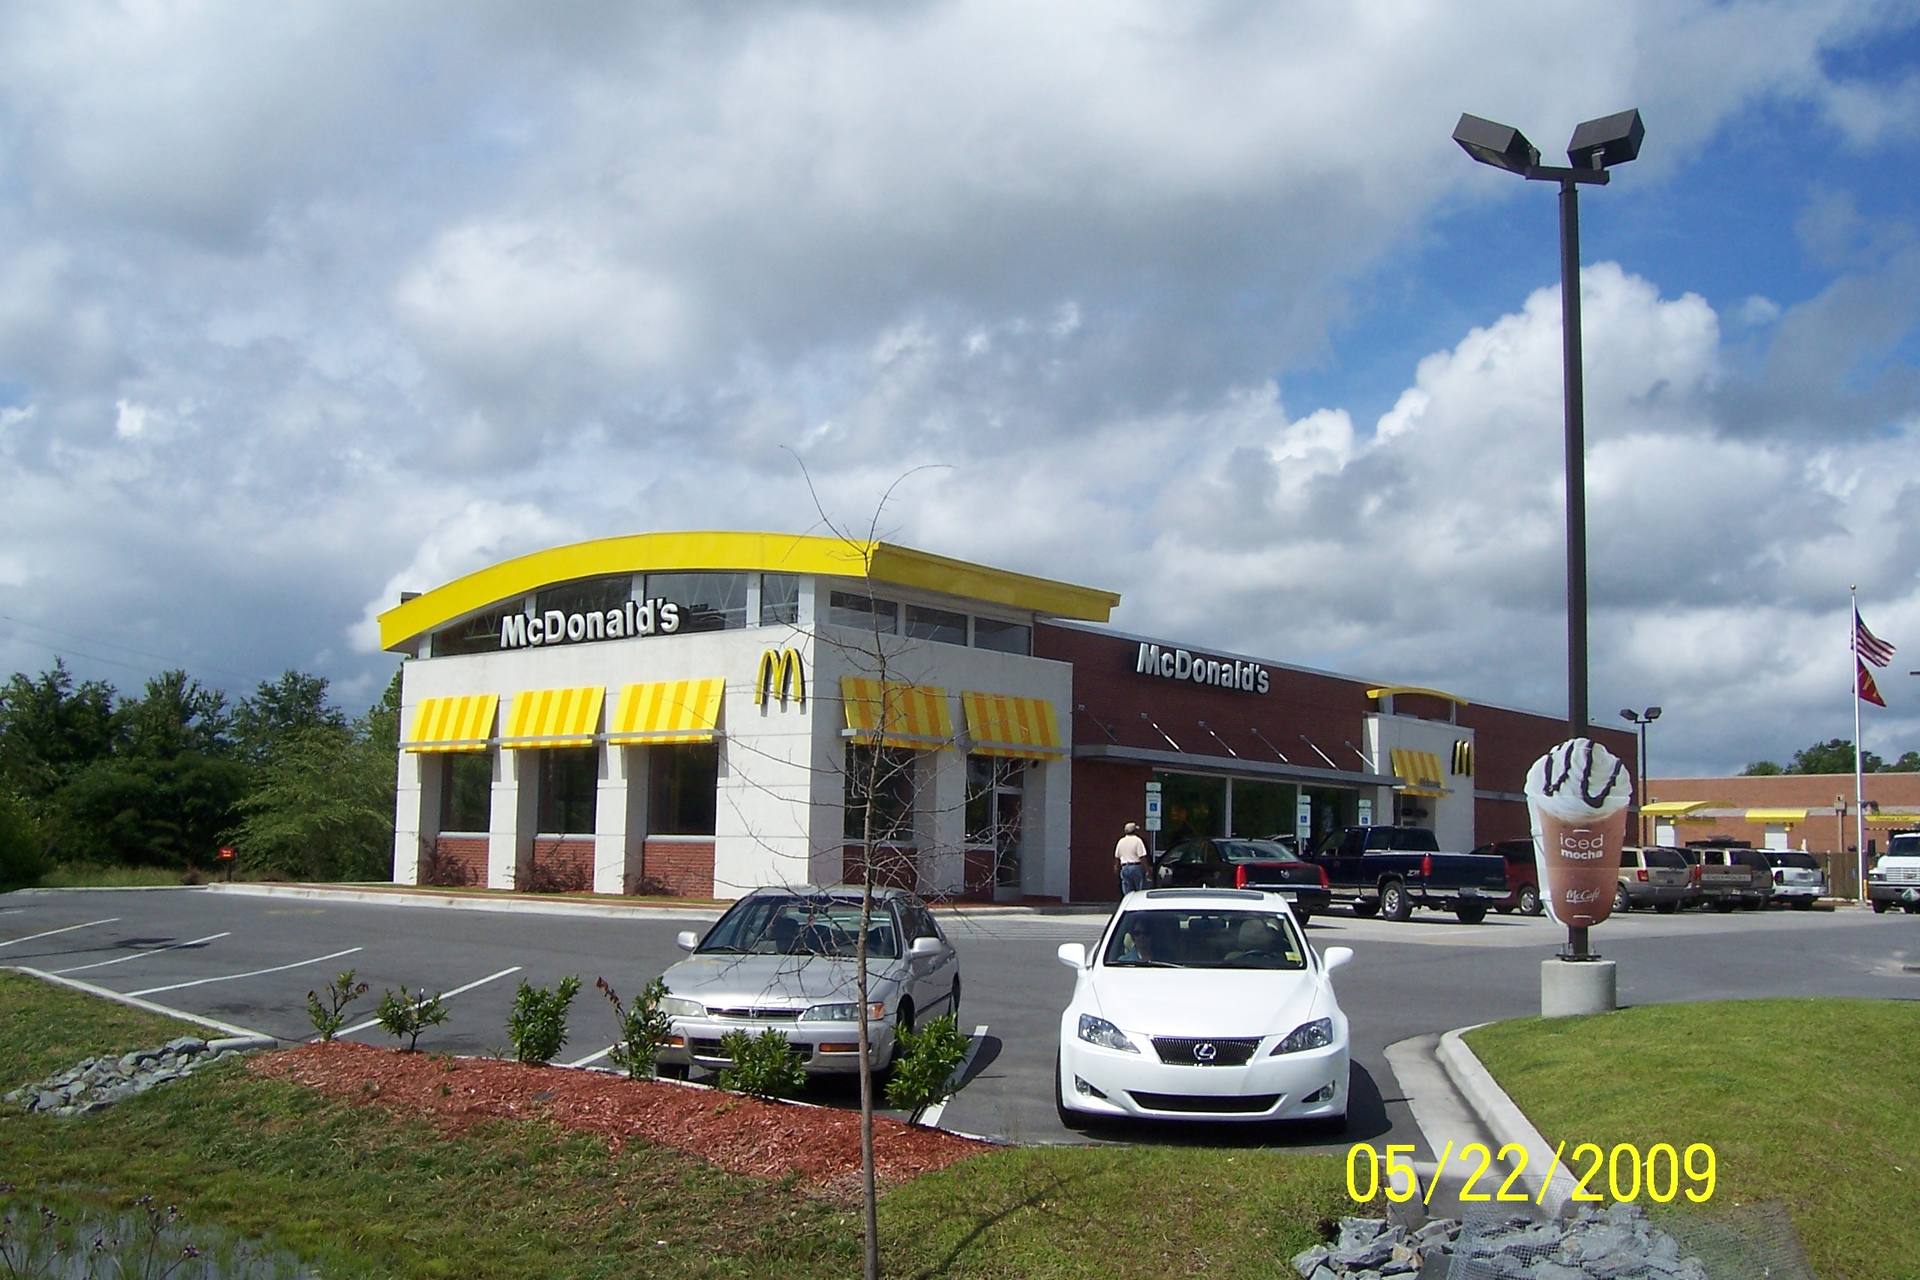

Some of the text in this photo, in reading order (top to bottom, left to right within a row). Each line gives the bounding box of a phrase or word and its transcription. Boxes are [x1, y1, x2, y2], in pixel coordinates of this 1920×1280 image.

[500, 598, 679, 648] McDonald's
[1136, 642, 1270, 694] McDonald's
[1560, 833, 1604, 849] iced
[1561, 849, 1603, 859] mocha
